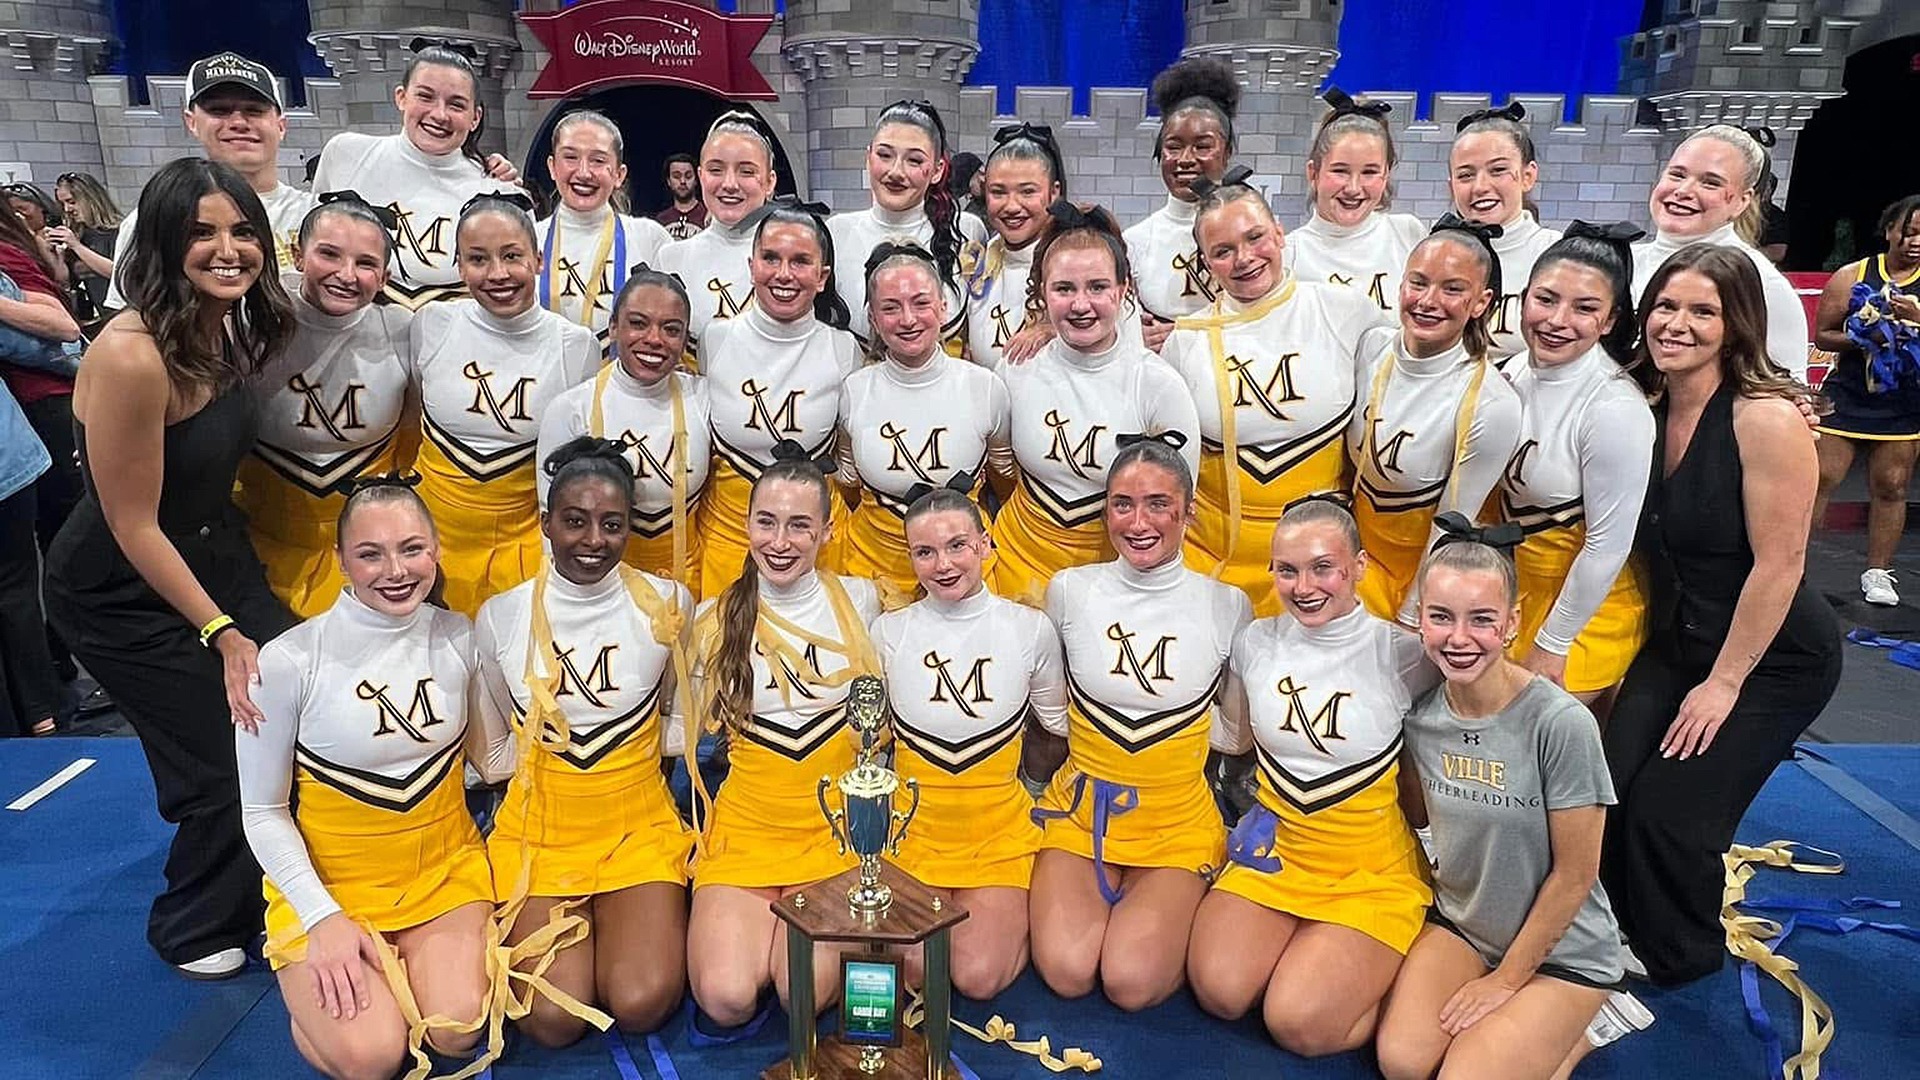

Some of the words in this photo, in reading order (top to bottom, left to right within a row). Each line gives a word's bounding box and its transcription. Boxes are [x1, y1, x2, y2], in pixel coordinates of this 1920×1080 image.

[659, 39, 697, 56] World
[289, 374, 365, 441] M
[463, 361, 536, 433] M
[742, 379, 804, 455] M
[1227, 355, 1305, 421] M
[880, 421, 948, 482] M
[1045, 409, 1106, 479] M
[552, 640, 619, 707] M
[924, 650, 993, 718] M
[1107, 622, 1177, 696] M
[356, 678, 443, 743] M
[1277, 676, 1351, 755] M
[1441, 751, 1506, 791] VILLE
